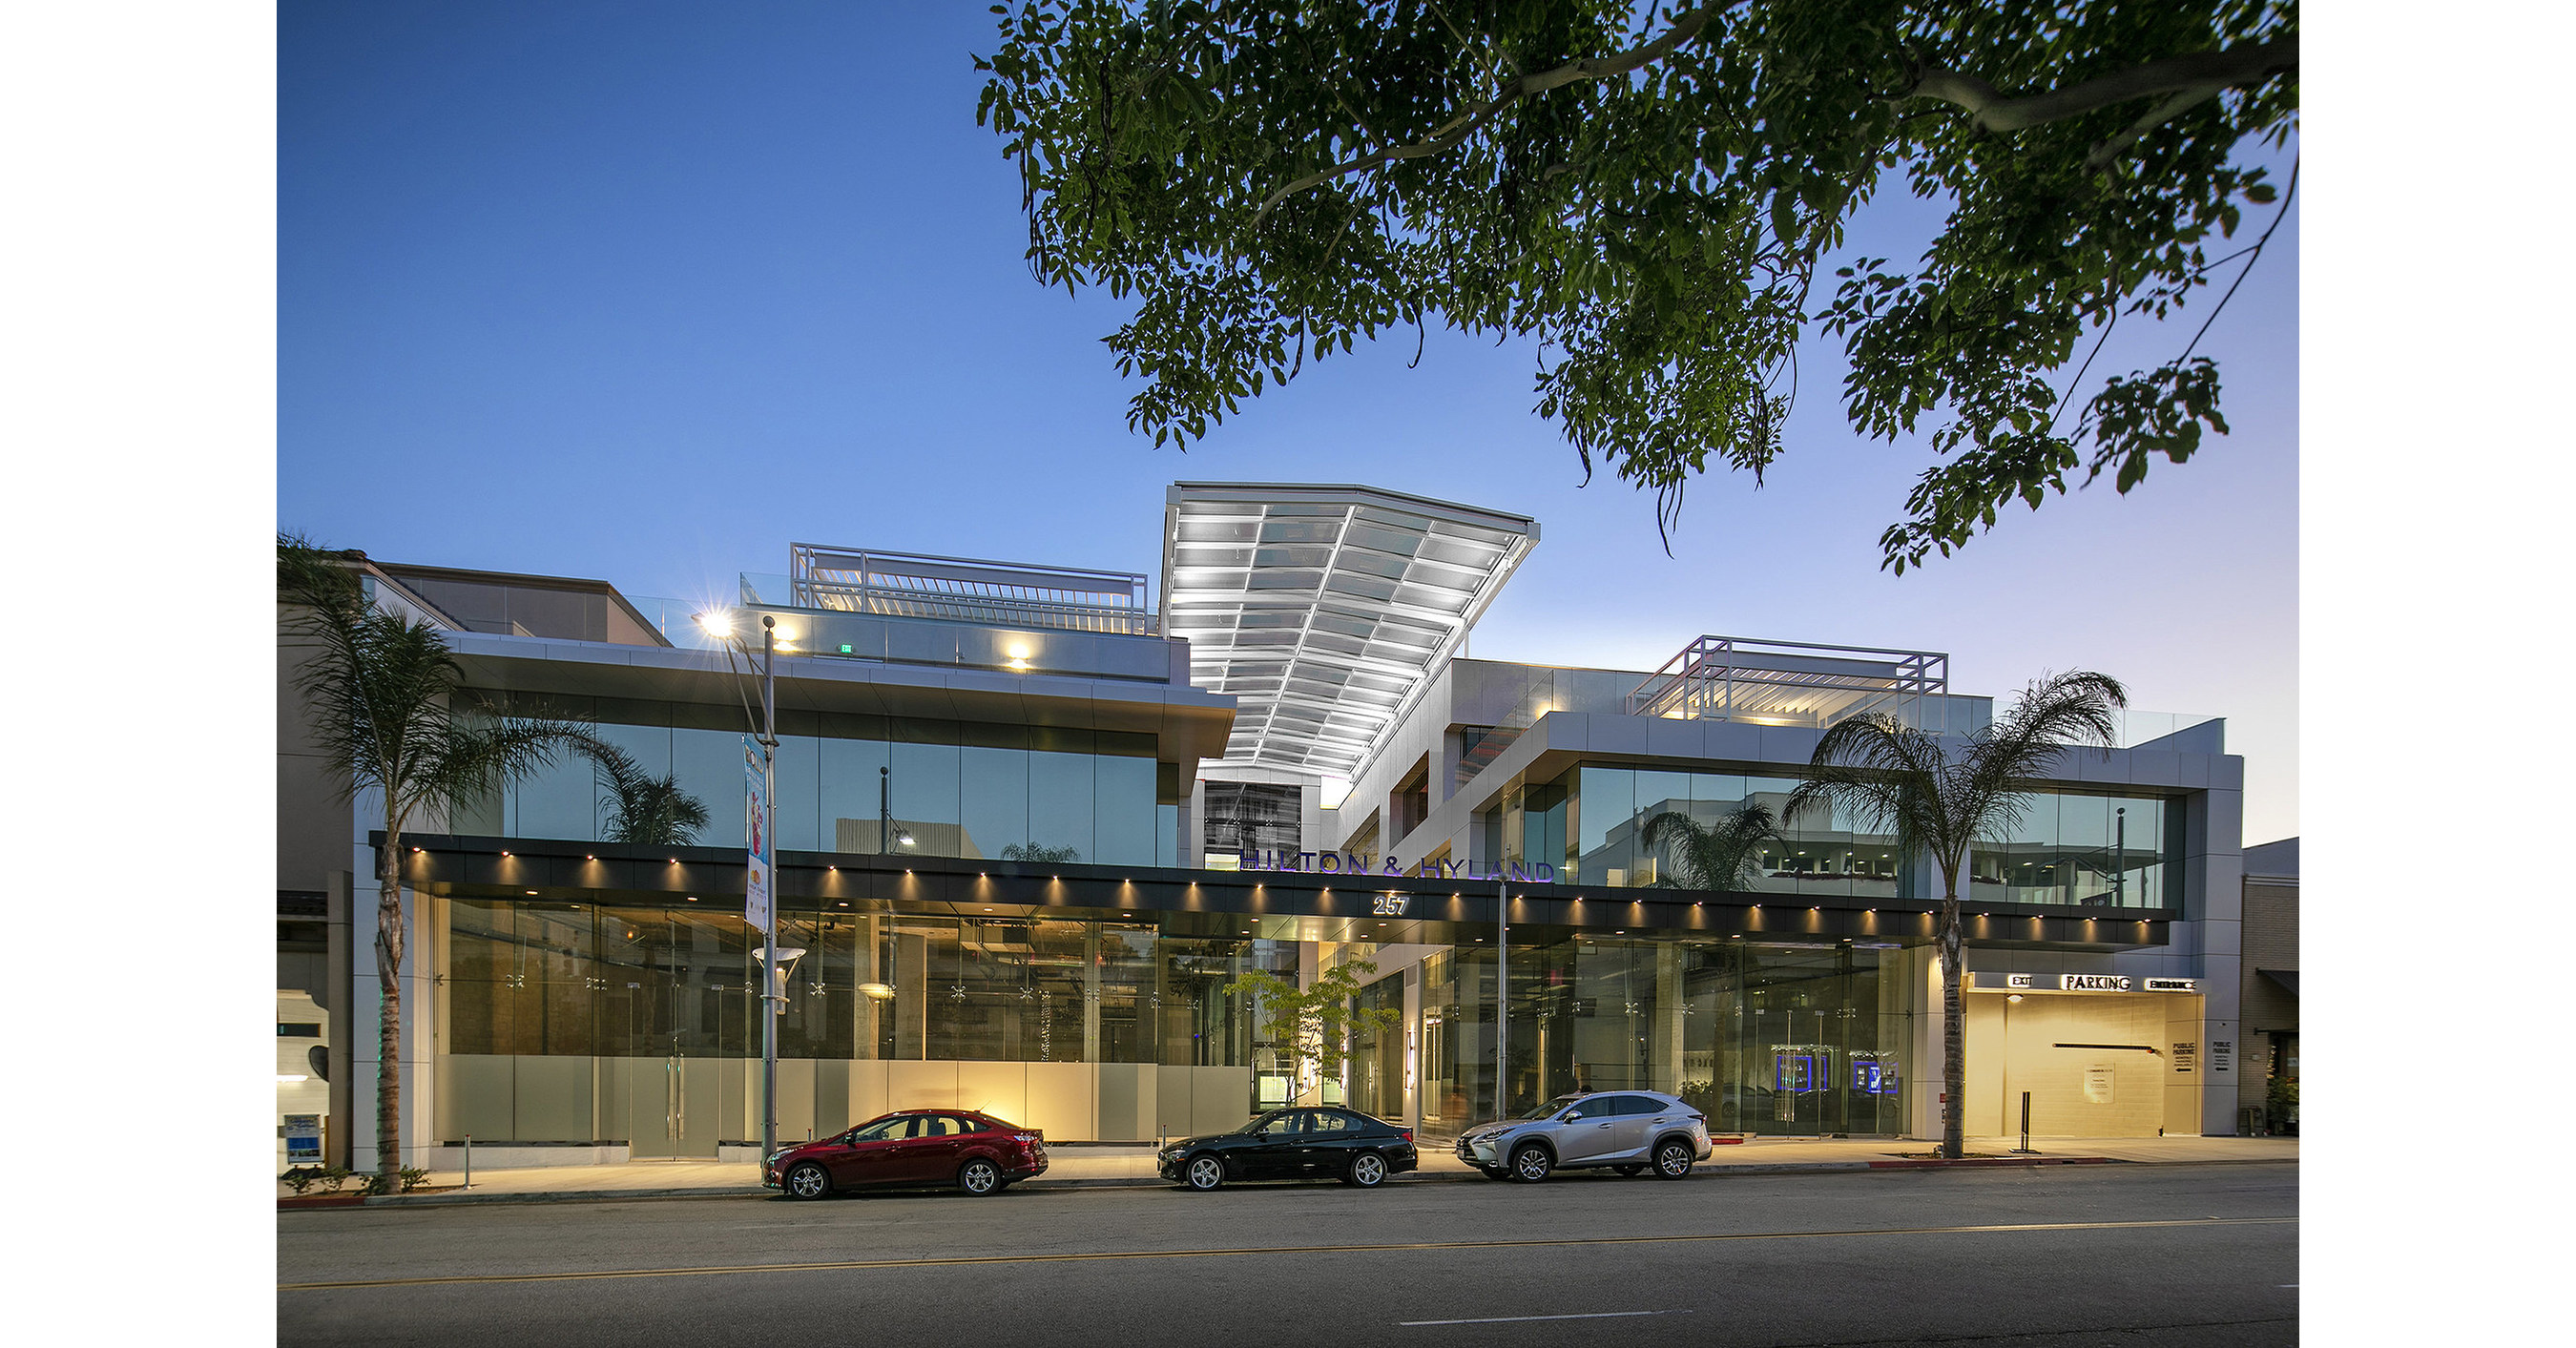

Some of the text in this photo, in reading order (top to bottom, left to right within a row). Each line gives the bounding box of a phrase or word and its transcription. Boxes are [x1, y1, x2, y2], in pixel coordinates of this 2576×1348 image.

[1239, 849, 1555, 883] HILTON & HYLAND
[1373, 896, 1410, 916] 257
[2012, 976, 2033, 985] EXIT
[2066, 975, 2131, 990] PARKING
